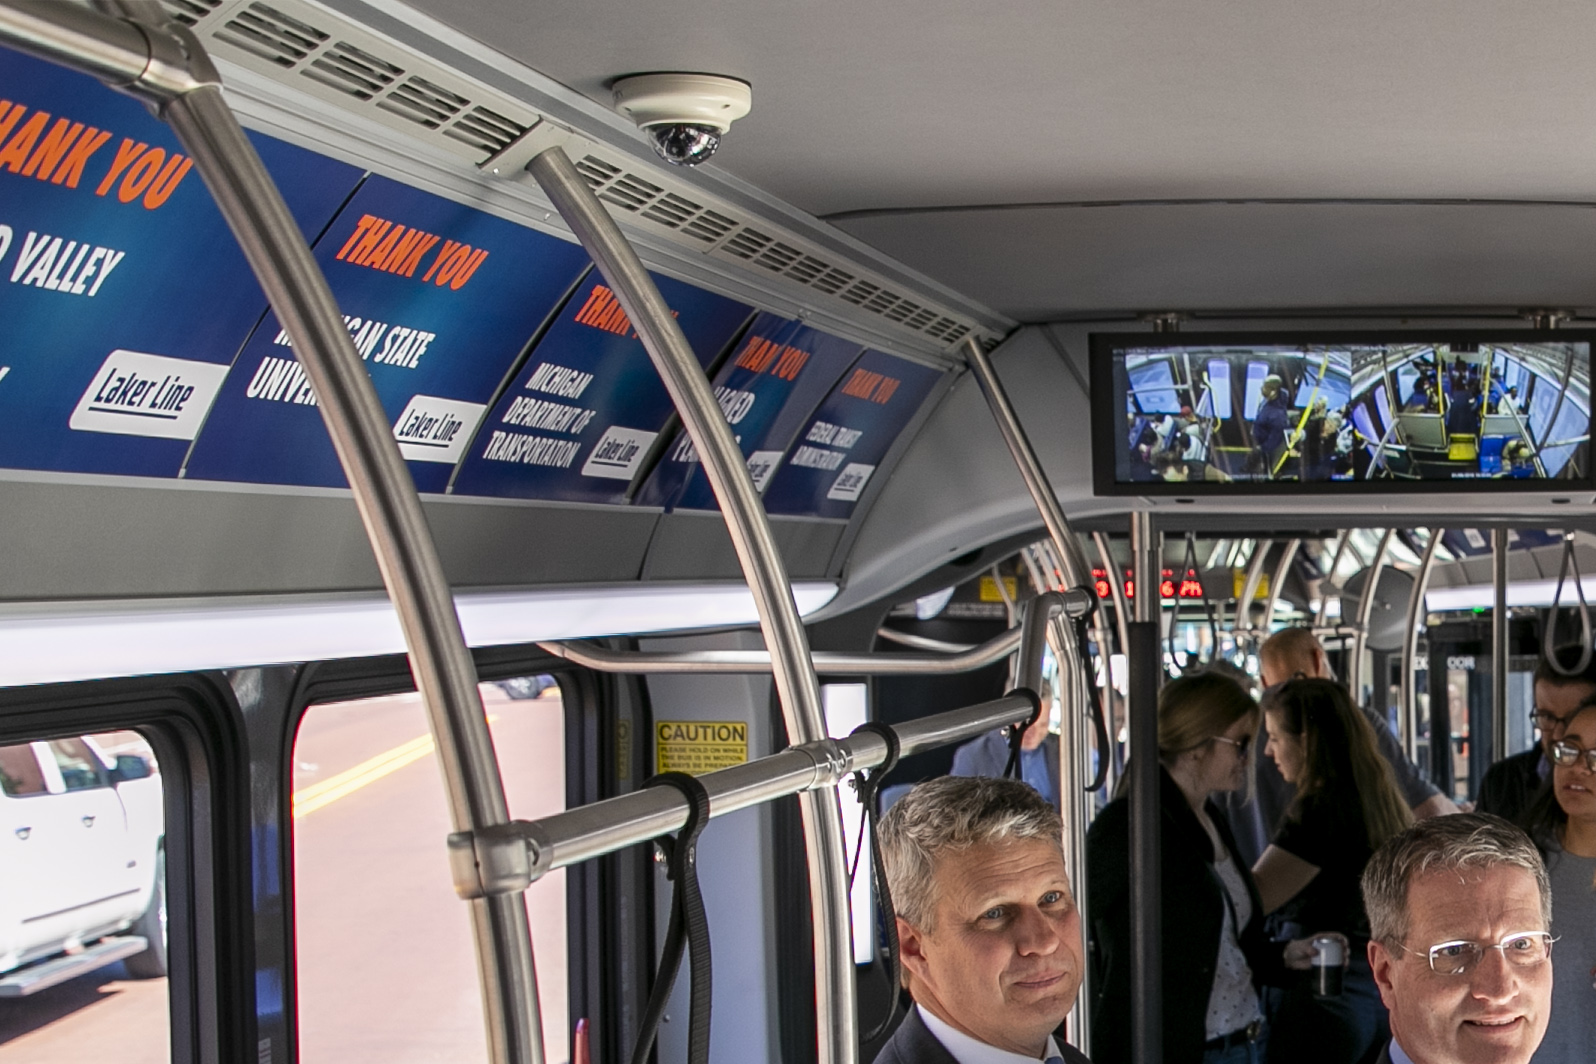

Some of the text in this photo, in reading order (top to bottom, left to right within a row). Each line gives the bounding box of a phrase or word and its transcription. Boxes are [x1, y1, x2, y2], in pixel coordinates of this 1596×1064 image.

[0, 100, 194, 211] HANK YOU
[10, 231, 125, 297] VALLEY
[335, 214, 489, 291] THANK YOU
[374, 325, 436, 369] STATE
[770, 346, 811, 382] YOU
[93, 367, 195, 412] Laker Line
[525, 362, 594, 399] MICHIGAN
[399, 409, 463, 441] Laker Line
[502, 396, 597, 435] DEPARTMENT OF
[482, 430, 582, 469] TRANSPORTATION
[659, 724, 745, 742] CAUTION
